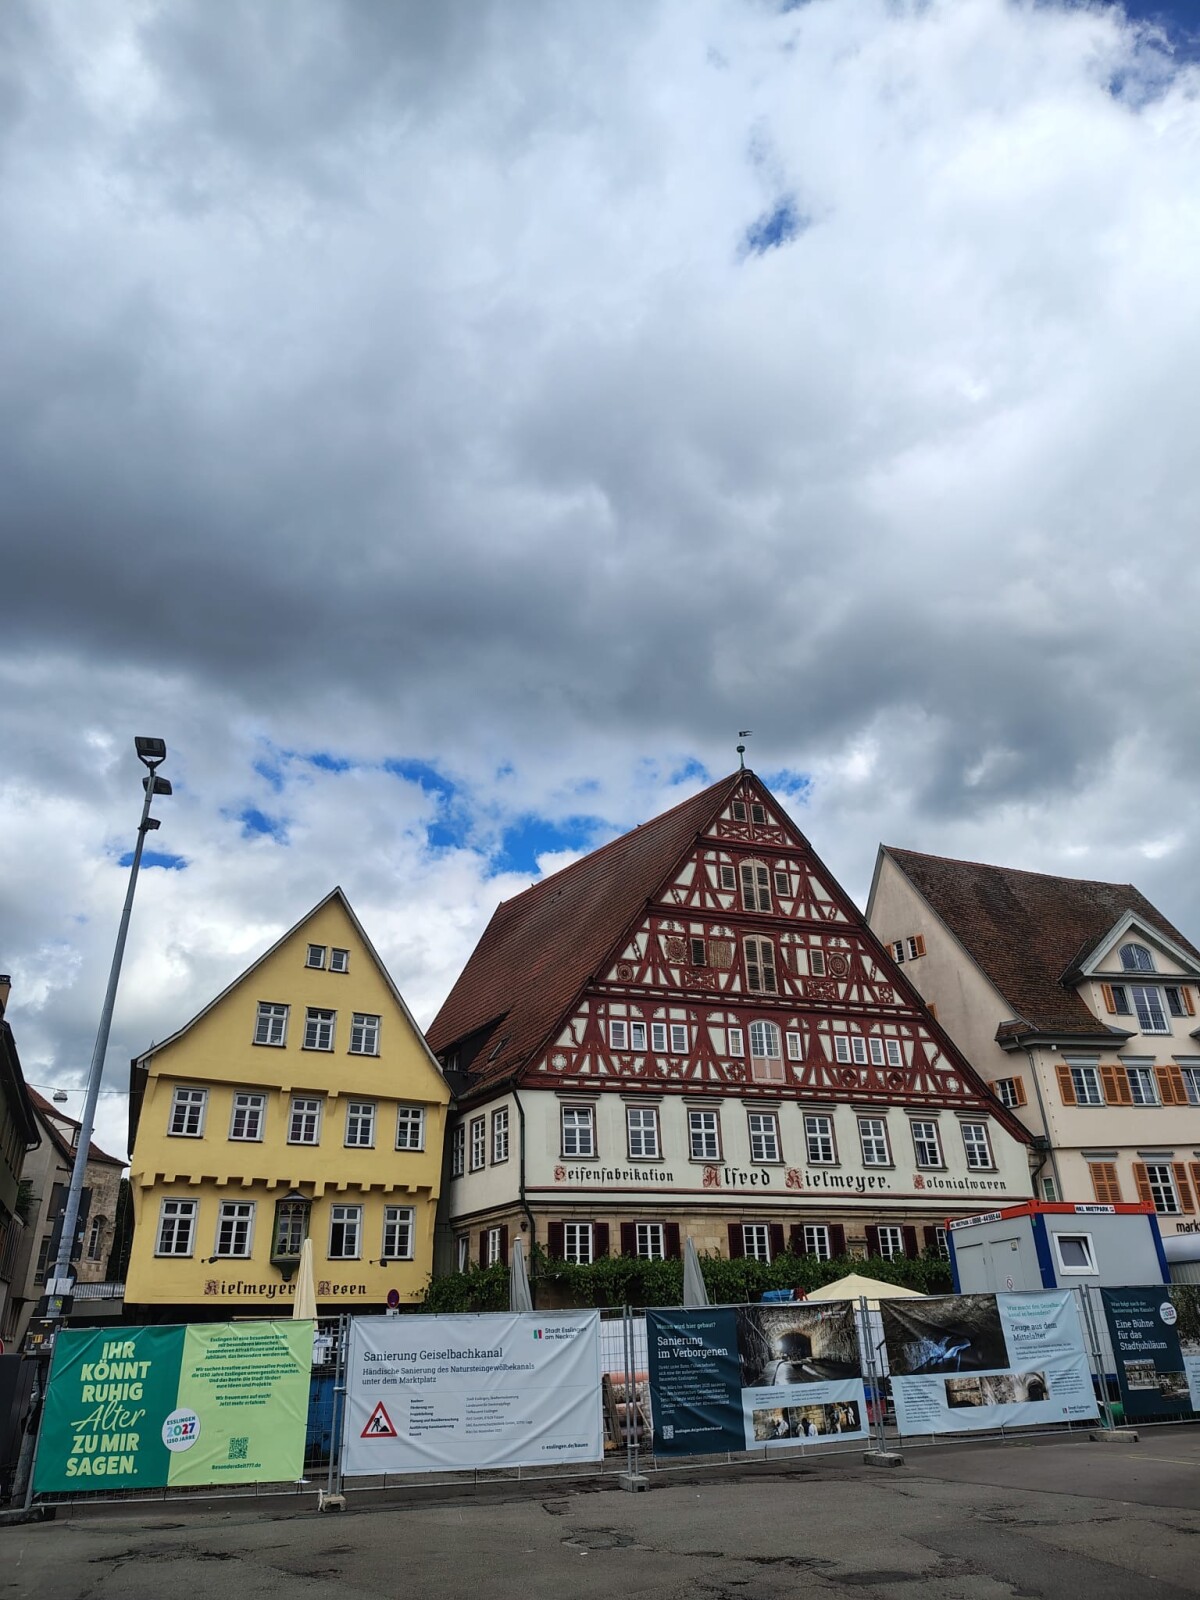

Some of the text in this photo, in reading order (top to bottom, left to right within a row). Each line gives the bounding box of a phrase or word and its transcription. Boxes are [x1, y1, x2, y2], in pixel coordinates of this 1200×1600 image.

[554, 1165, 674, 1183] Seifenfabrikation
[703, 1165, 891, 1192] Alfred Kielmeyer.
[913, 1174, 1007, 1190] Kolonialwaren
[1176, 1219, 1200, 1232] mark
[317, 1279, 367, 1295] Besen
[1010, 1324, 1030, 1332] Zeuge
[1115, 1319, 1154, 1329] Eine Bühne
[657, 1336, 703, 1347] Sanierung
[1013, 1332, 1046, 1341] Mittelalter
[1118, 1330, 1142, 1339] für das
[102, 1341, 136, 1359] IHR
[658, 1347, 728, 1359] im Verborgenen
[1120, 1340, 1168, 1352] Stadtjubiläum
[363, 1347, 503, 1363] Sanierung Geiselbachkanal
[80, 1359, 152, 1381] KÖNNT
[362, 1367, 399, 1375] Händische
[401, 1367, 436, 1375] Sanierung
[450, 1363, 535, 1374] Natursteingewölbekanals
[399, 1376, 437, 1384] Marktplatz
[82, 1382, 143, 1402] RUHIG
[70, 1399, 146, 1432] Alter
[167, 1416, 196, 1425] ESSLINGEN
[167, 1422, 195, 1437] 2027
[71, 1433, 140, 1454] ZU MIR
[65, 1455, 138, 1477] SAGEN.
